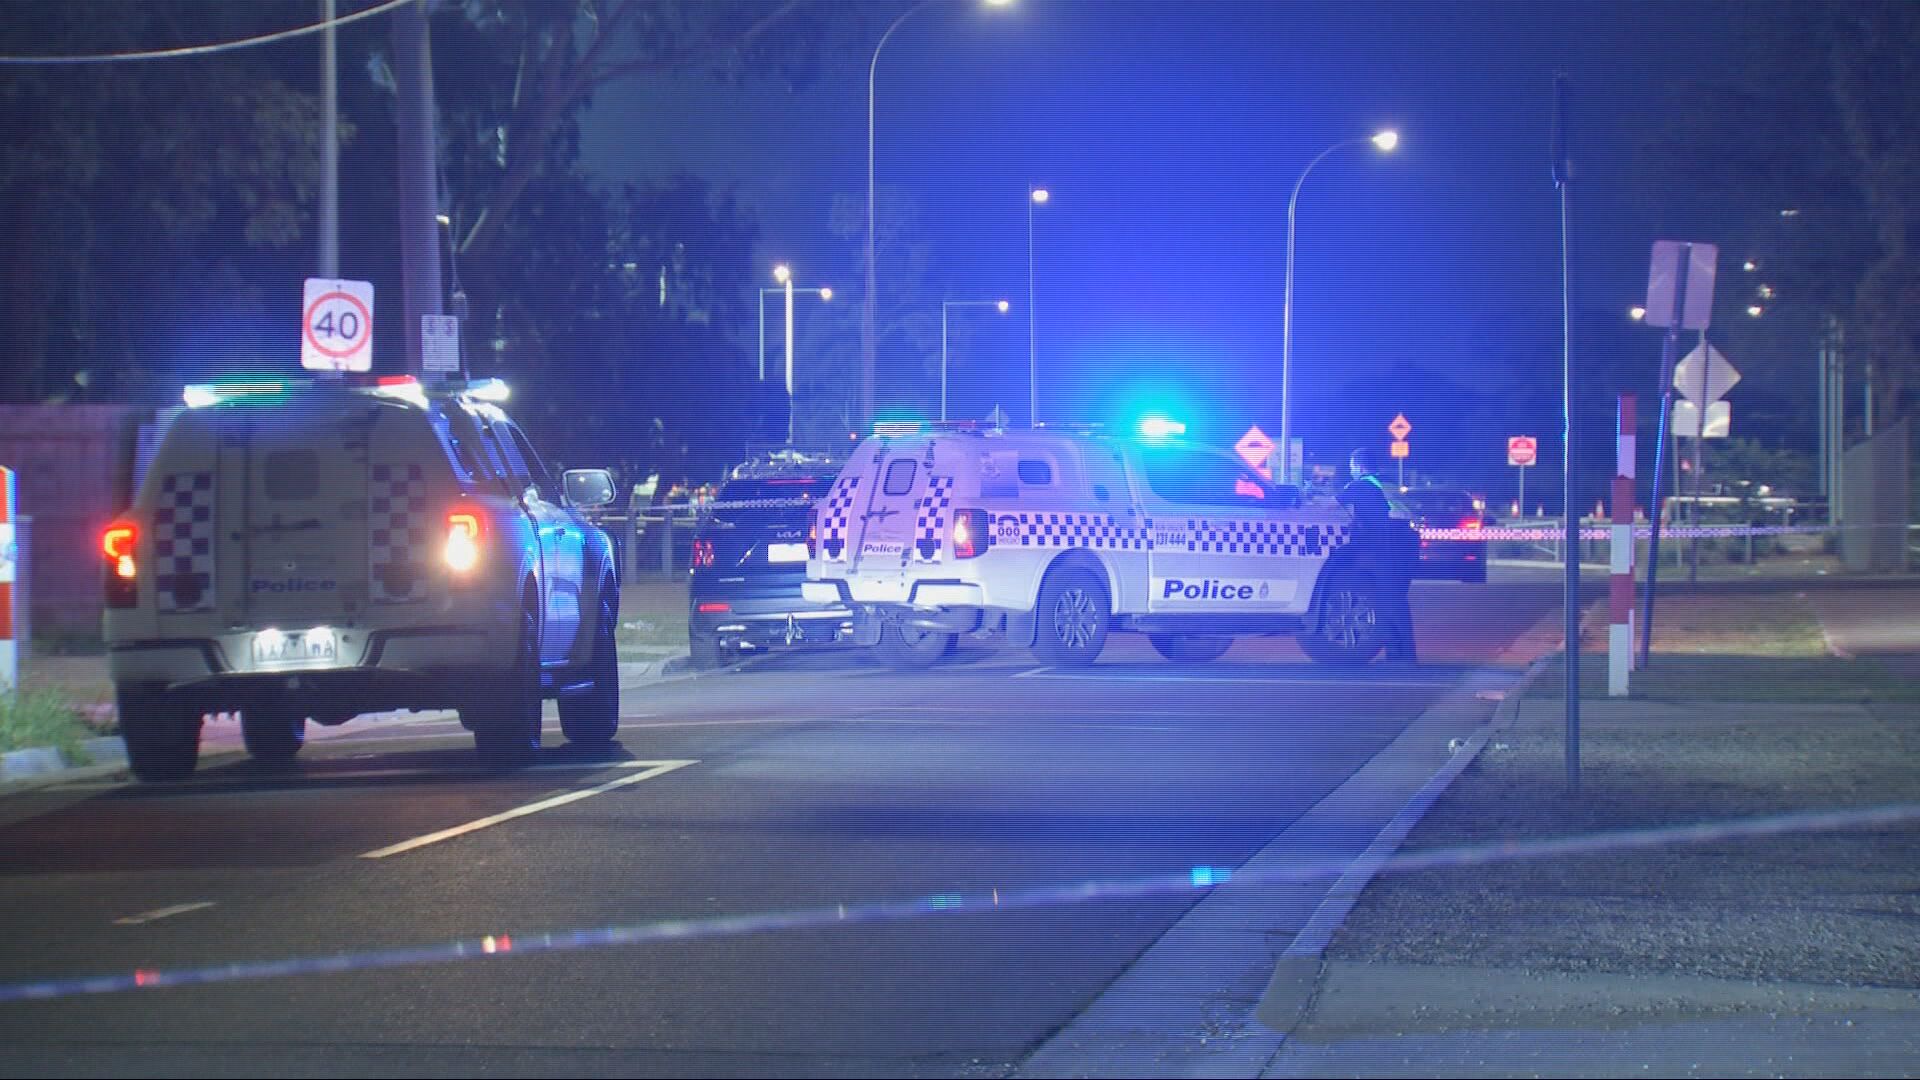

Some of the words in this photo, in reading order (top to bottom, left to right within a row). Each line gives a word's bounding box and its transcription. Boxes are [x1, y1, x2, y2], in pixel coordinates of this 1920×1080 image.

[313, 311, 358, 340] 40
[998, 527, 1020, 537] 000
[863, 543, 902, 553] Police
[251, 578, 337, 593] Police
[1163, 579, 1254, 599] Police
